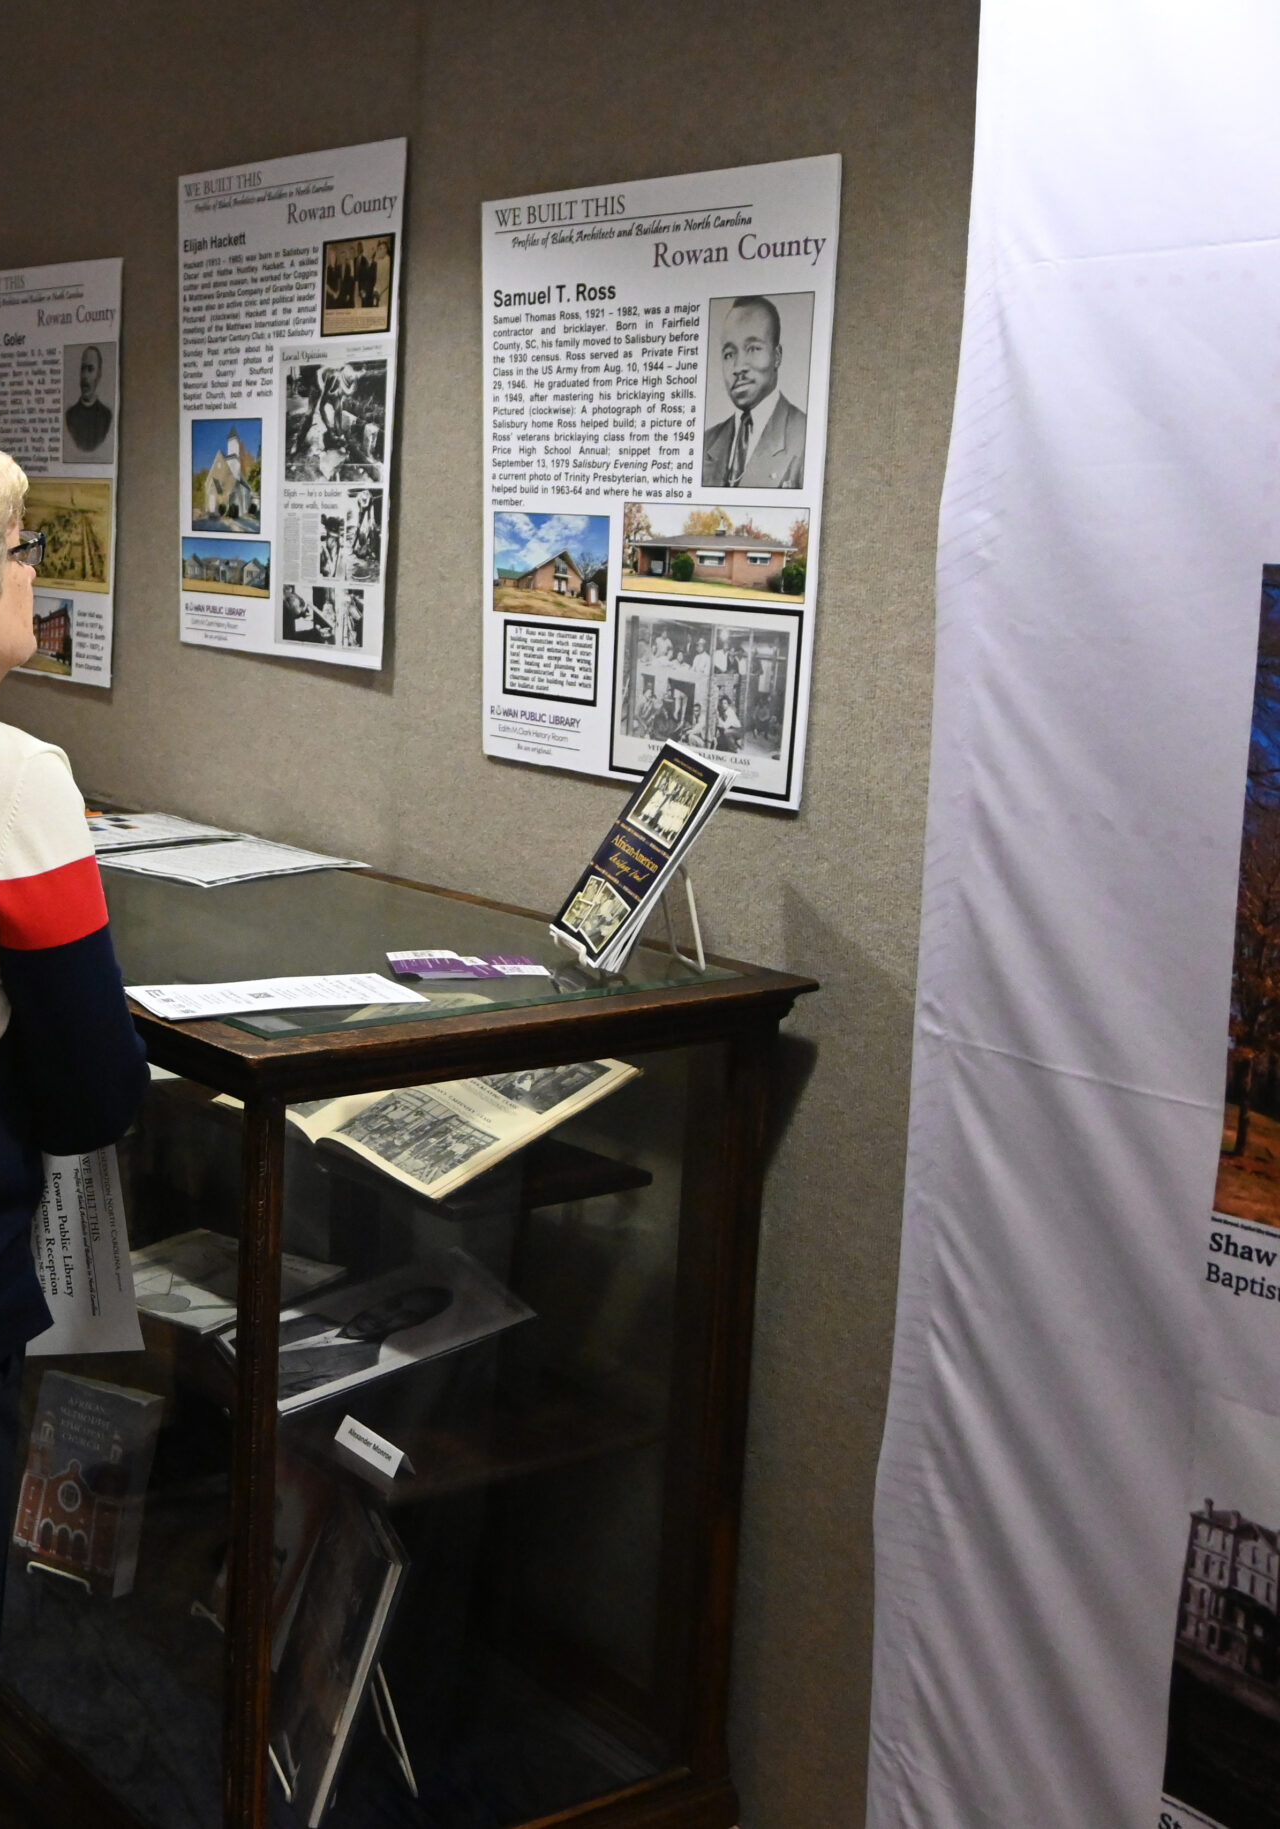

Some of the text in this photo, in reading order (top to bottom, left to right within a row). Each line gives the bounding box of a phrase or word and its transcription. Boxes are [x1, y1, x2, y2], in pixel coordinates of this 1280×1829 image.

[184, 182, 200, 197] WE
[203, 175, 234, 195] BUILT
[236, 170, 262, 189] THIS
[286, 202, 336, 224] Rowan
[341, 194, 398, 219] County
[494, 194, 626, 228] WE BUILT THIS
[512, 211, 752, 251] Profiles of Black Architects and Builders in North Carolina
[183, 232, 246, 254] Elijah Hackett
[653, 233, 827, 268] Rowan County
[493, 282, 616, 308] Samuel T. Ross
[37, 304, 116, 327] Rowan County
[493, 314, 522, 325] Samuel
[525, 313, 556, 322] Thomas
[585, 308, 605, 319] 1921
[643, 307, 662, 315] was
[673, 303, 701, 316] major
[493, 328, 533, 338] contractor
[540, 325, 556, 335] and
[615, 321, 637, 331] Born
[645, 319, 654, 330] in
[661, 317, 700, 329] Fairfield
[3, 332, 26, 346] Goler
[541, 340, 553, 348] his
[555, 337, 580, 349] family
[582, 335, 611, 346] moved
[613, 336, 623, 345] to
[624, 333, 667, 346] Salisbury
[668, 332, 700, 343] before
[493, 355, 505, 364] the
[509, 353, 528, 363] 1930
[565, 351, 586, 361] Ross
[590, 349, 619, 360] served
[622, 350, 633, 359] as
[641, 347, 674, 358] Private
[677, 346, 699, 357] First
[534, 379, 545, 389] He
[548, 378, 590, 391] graduated
[592, 377, 613, 387] from
[616, 376, 639, 386] Price
[641, 375, 663, 388] High
[666, 374, 698, 385] School
[529, 392, 548, 402] after
[553, 392, 594, 404] mastering
[599, 391, 612, 400] his
[616, 389, 665, 402] bricklaying
[493, 406, 525, 416] Pictured
[580, 405, 587, 414] A
[592, 404, 642, 417] photograph
[646, 403, 656, 414] of
[690, 405, 696, 413] a
[493, 419, 528, 431] Salisbury
[531, 419, 554, 428] home
[557, 418, 577, 428] Ross
[580, 418, 609, 430] helped
[641, 420, 646, 428] a
[650, 417, 682, 430] picture
[686, 417, 696, 428] of
[517, 433, 550, 442] veterans
[554, 432, 599, 444] bricklaying
[603, 432, 625, 442] class
[629, 431, 650, 442] from
[654, 431, 668, 442] the
[673, 431, 695, 442] 1949
[492, 445, 512, 455] Price
[519, 445, 537, 457] High
[544, 445, 572, 455] School
[618, 446, 651, 458] snippet
[659, 445, 680, 456] from
[688, 448, 694, 456] a
[492, 458, 534, 469] September
[551, 458, 570, 468] 1979
[572, 459, 611, 471] Salisbury
[613, 459, 648, 472] Evening
[676, 460, 694, 470] and
[520, 710, 547, 723] PUBLIC
[549, 715, 581, 728] LIBRARY
[82, 1156, 101, 1242] WE BUILT THIS
[52, 1172, 74, 1298] Rowan Public Library
[1209, 1232, 1277, 1267] Shaw
[45, 1238, 60, 1296] Reception
[348, 1428, 392, 1462] Alexander Monroe
